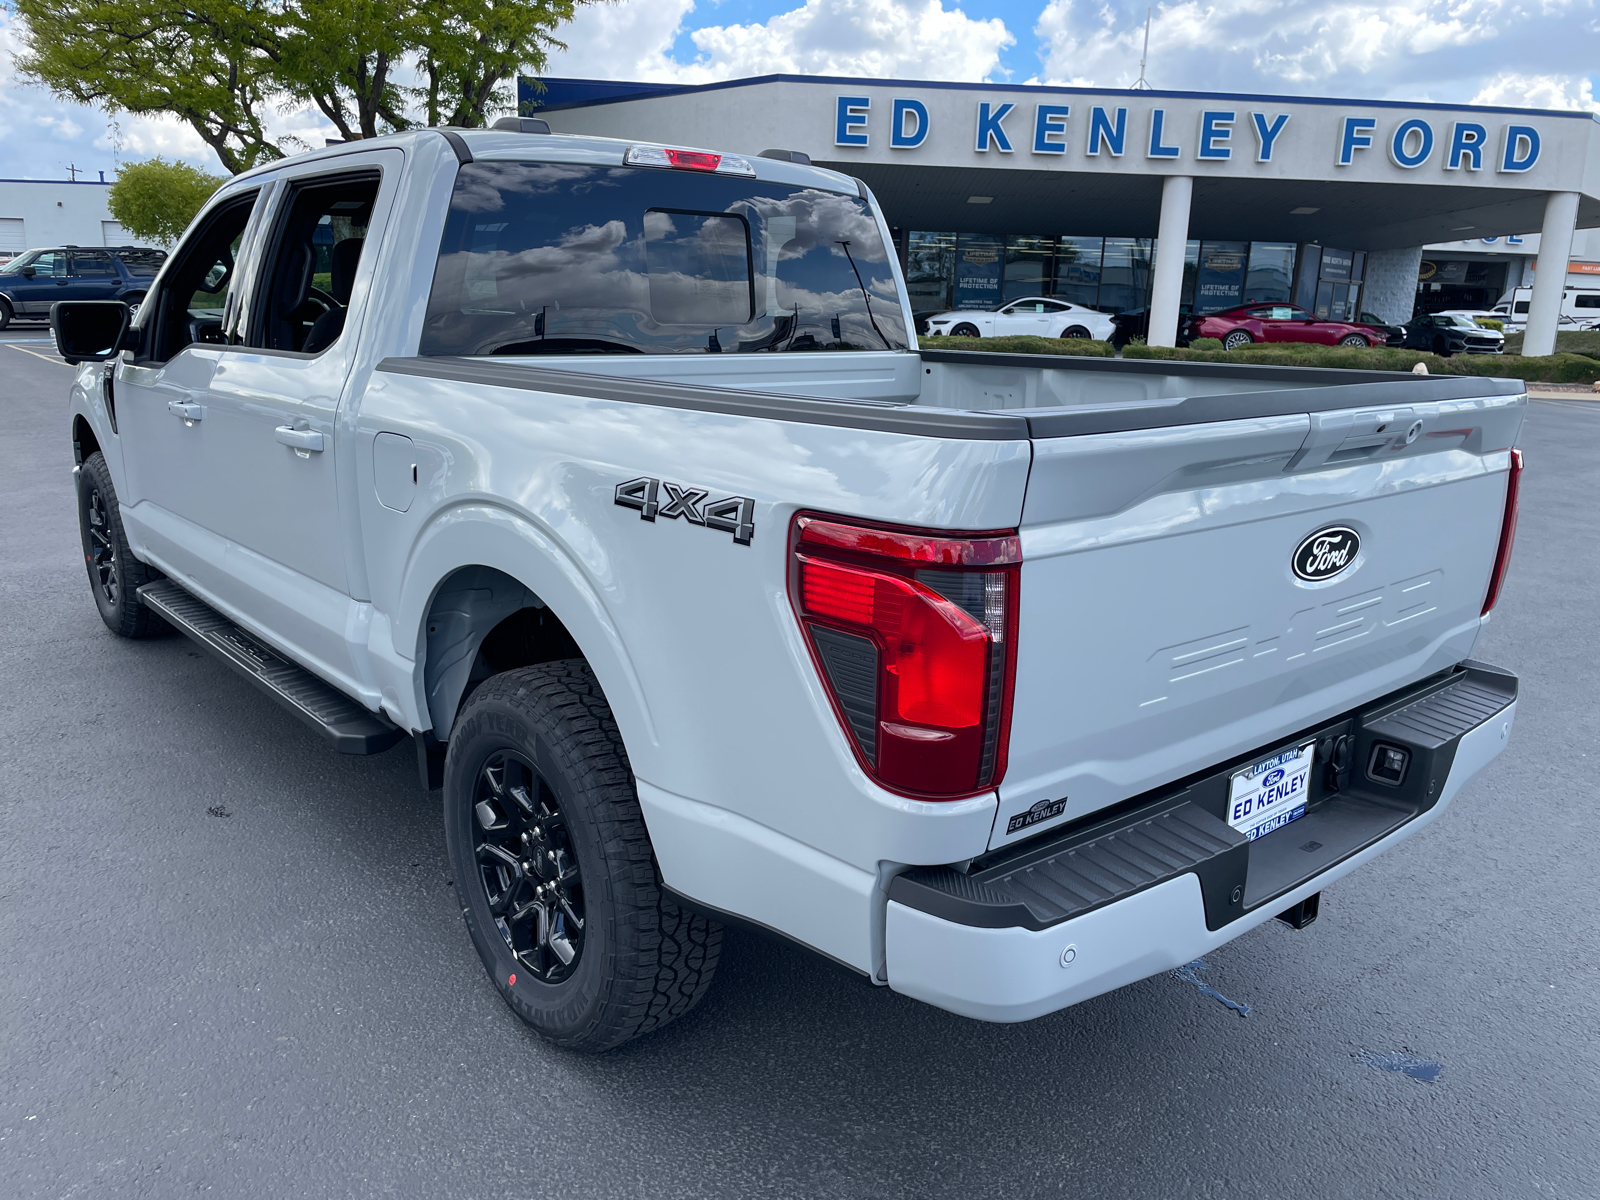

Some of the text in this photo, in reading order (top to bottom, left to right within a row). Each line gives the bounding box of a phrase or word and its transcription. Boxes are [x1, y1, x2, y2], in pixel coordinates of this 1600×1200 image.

[834, 95, 1542, 174] ED KENLEY FORD
[1305, 534, 1352, 574] Ford
[225, 635, 274, 662] FORD
[830, 646, 876, 664] FORD
[1281, 748, 1299, 763] UTAH
[1266, 769, 1283, 787] Ford
[1233, 771, 1306, 820] ED KENLEY
[1008, 801, 1066, 831] ED KENLEY
[1258, 810, 1292, 838] KENLEY
